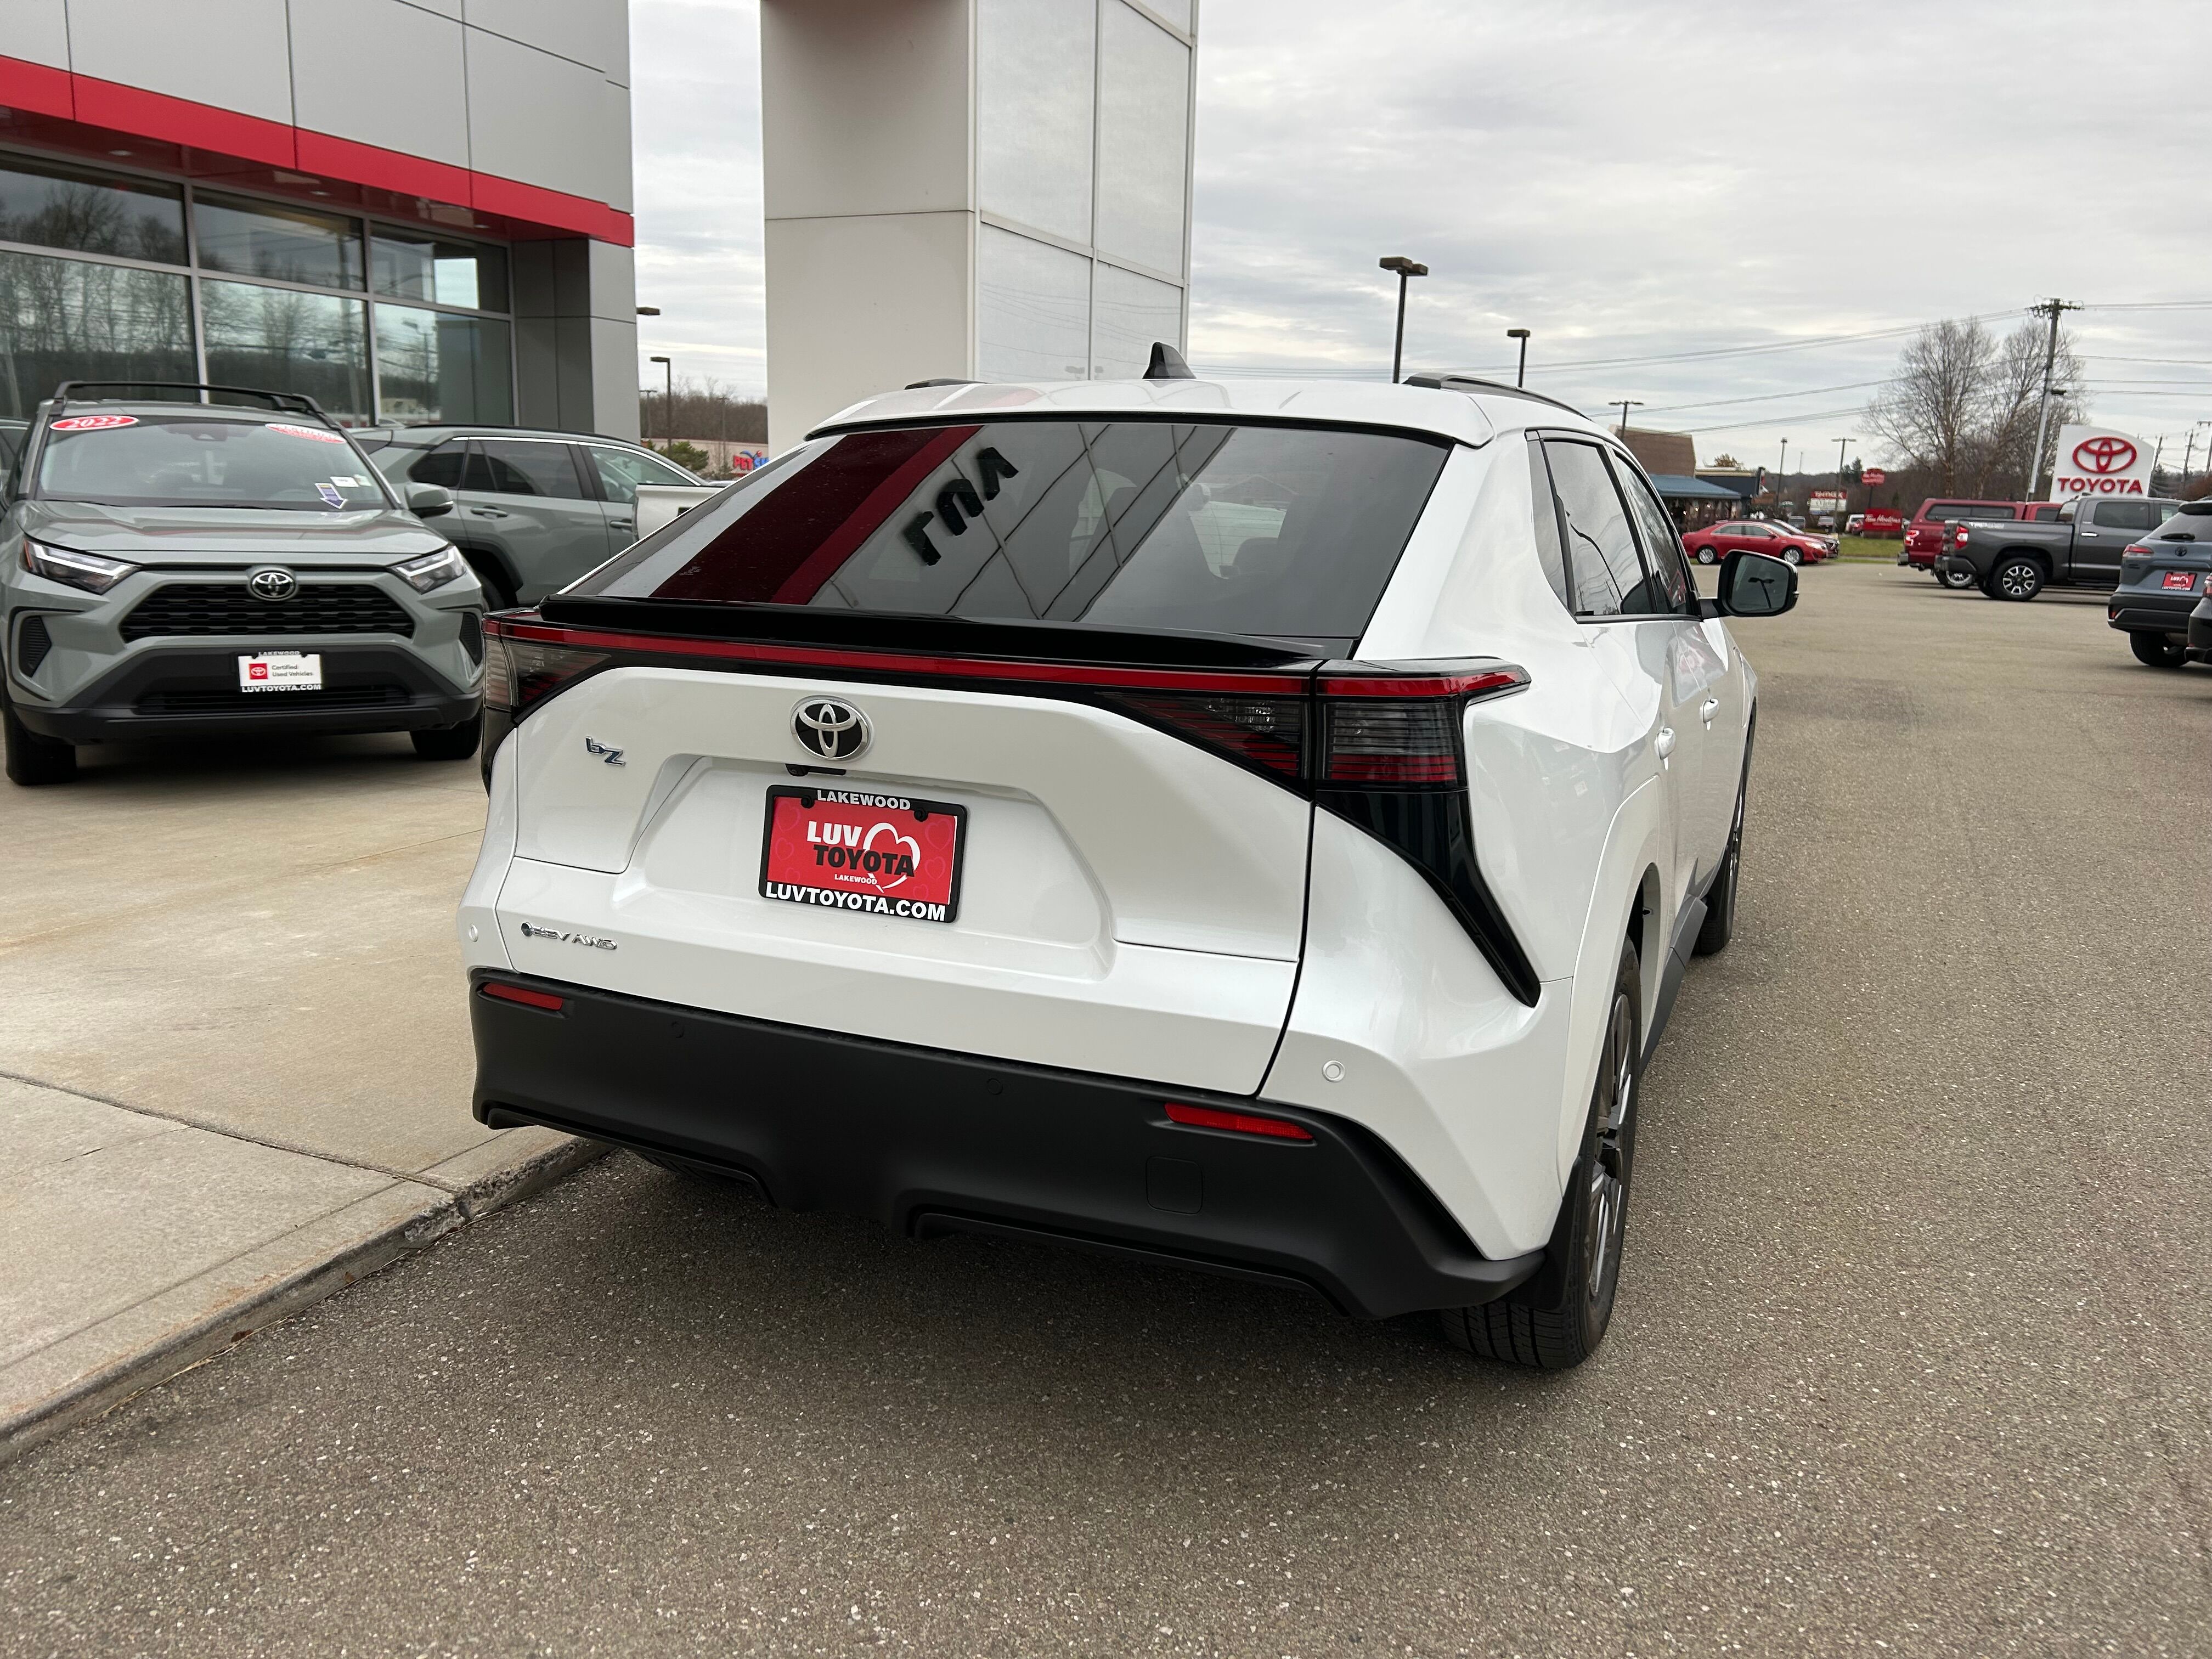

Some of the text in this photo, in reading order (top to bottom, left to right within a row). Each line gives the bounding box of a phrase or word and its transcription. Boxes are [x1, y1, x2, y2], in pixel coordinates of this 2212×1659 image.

[65, 416, 122, 428] 2022
[2058, 478, 2143, 494] TOYOTA
[1865, 514, 1876, 522] Tim
[241, 684, 321, 692] LUVTOYOTA.COM
[817, 790, 911, 810] LAKEWOOD
[806, 821, 863, 848] LUV
[813, 844, 915, 877] TOYOTA
[834, 873, 878, 885] LAKEWOOD
[765, 882, 946, 922] LUVTOYOTA.COM
[571, 934, 618, 950] AWD
